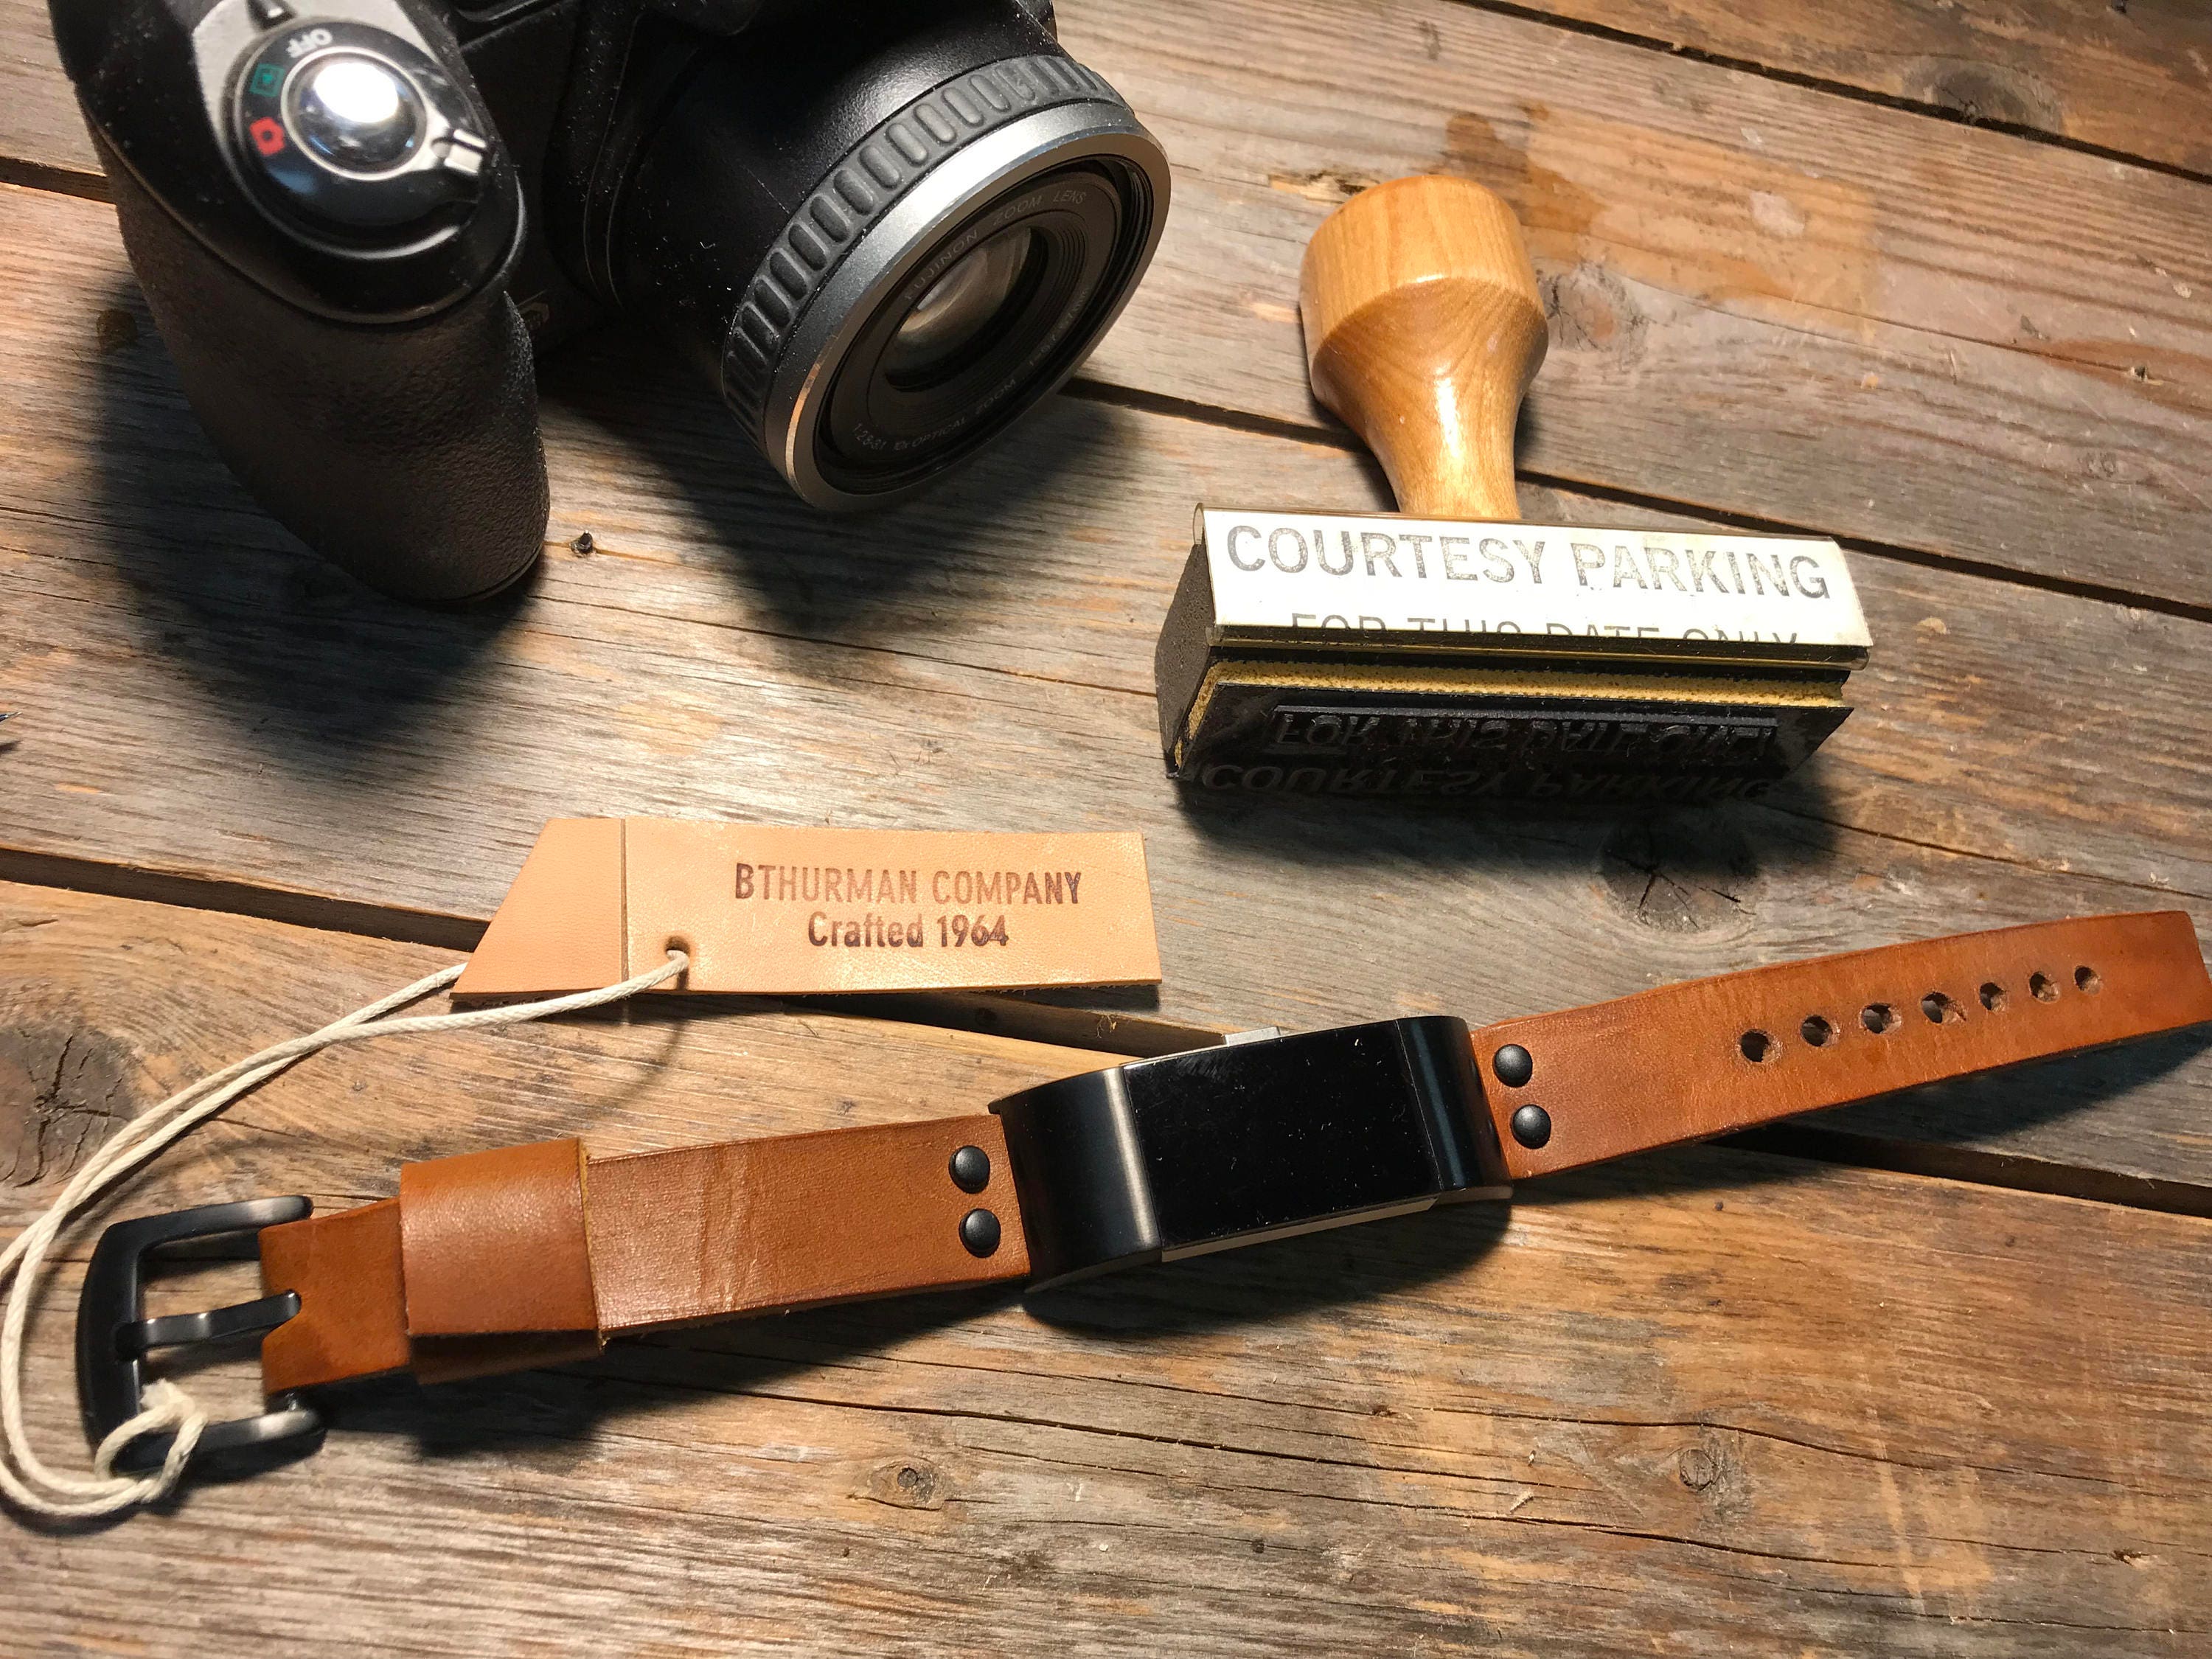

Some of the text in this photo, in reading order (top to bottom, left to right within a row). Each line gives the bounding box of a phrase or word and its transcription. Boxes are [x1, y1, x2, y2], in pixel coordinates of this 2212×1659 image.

[287, 28, 333, 58] OFF
[904, 189, 1087, 301] FUJINON ZOOM LENS
[1227, 525, 1831, 599] COURTESY PARKING
[734, 862, 1082, 905] BTHURMAN COMPANY
[807, 911, 1009, 948] Crafted 1964
